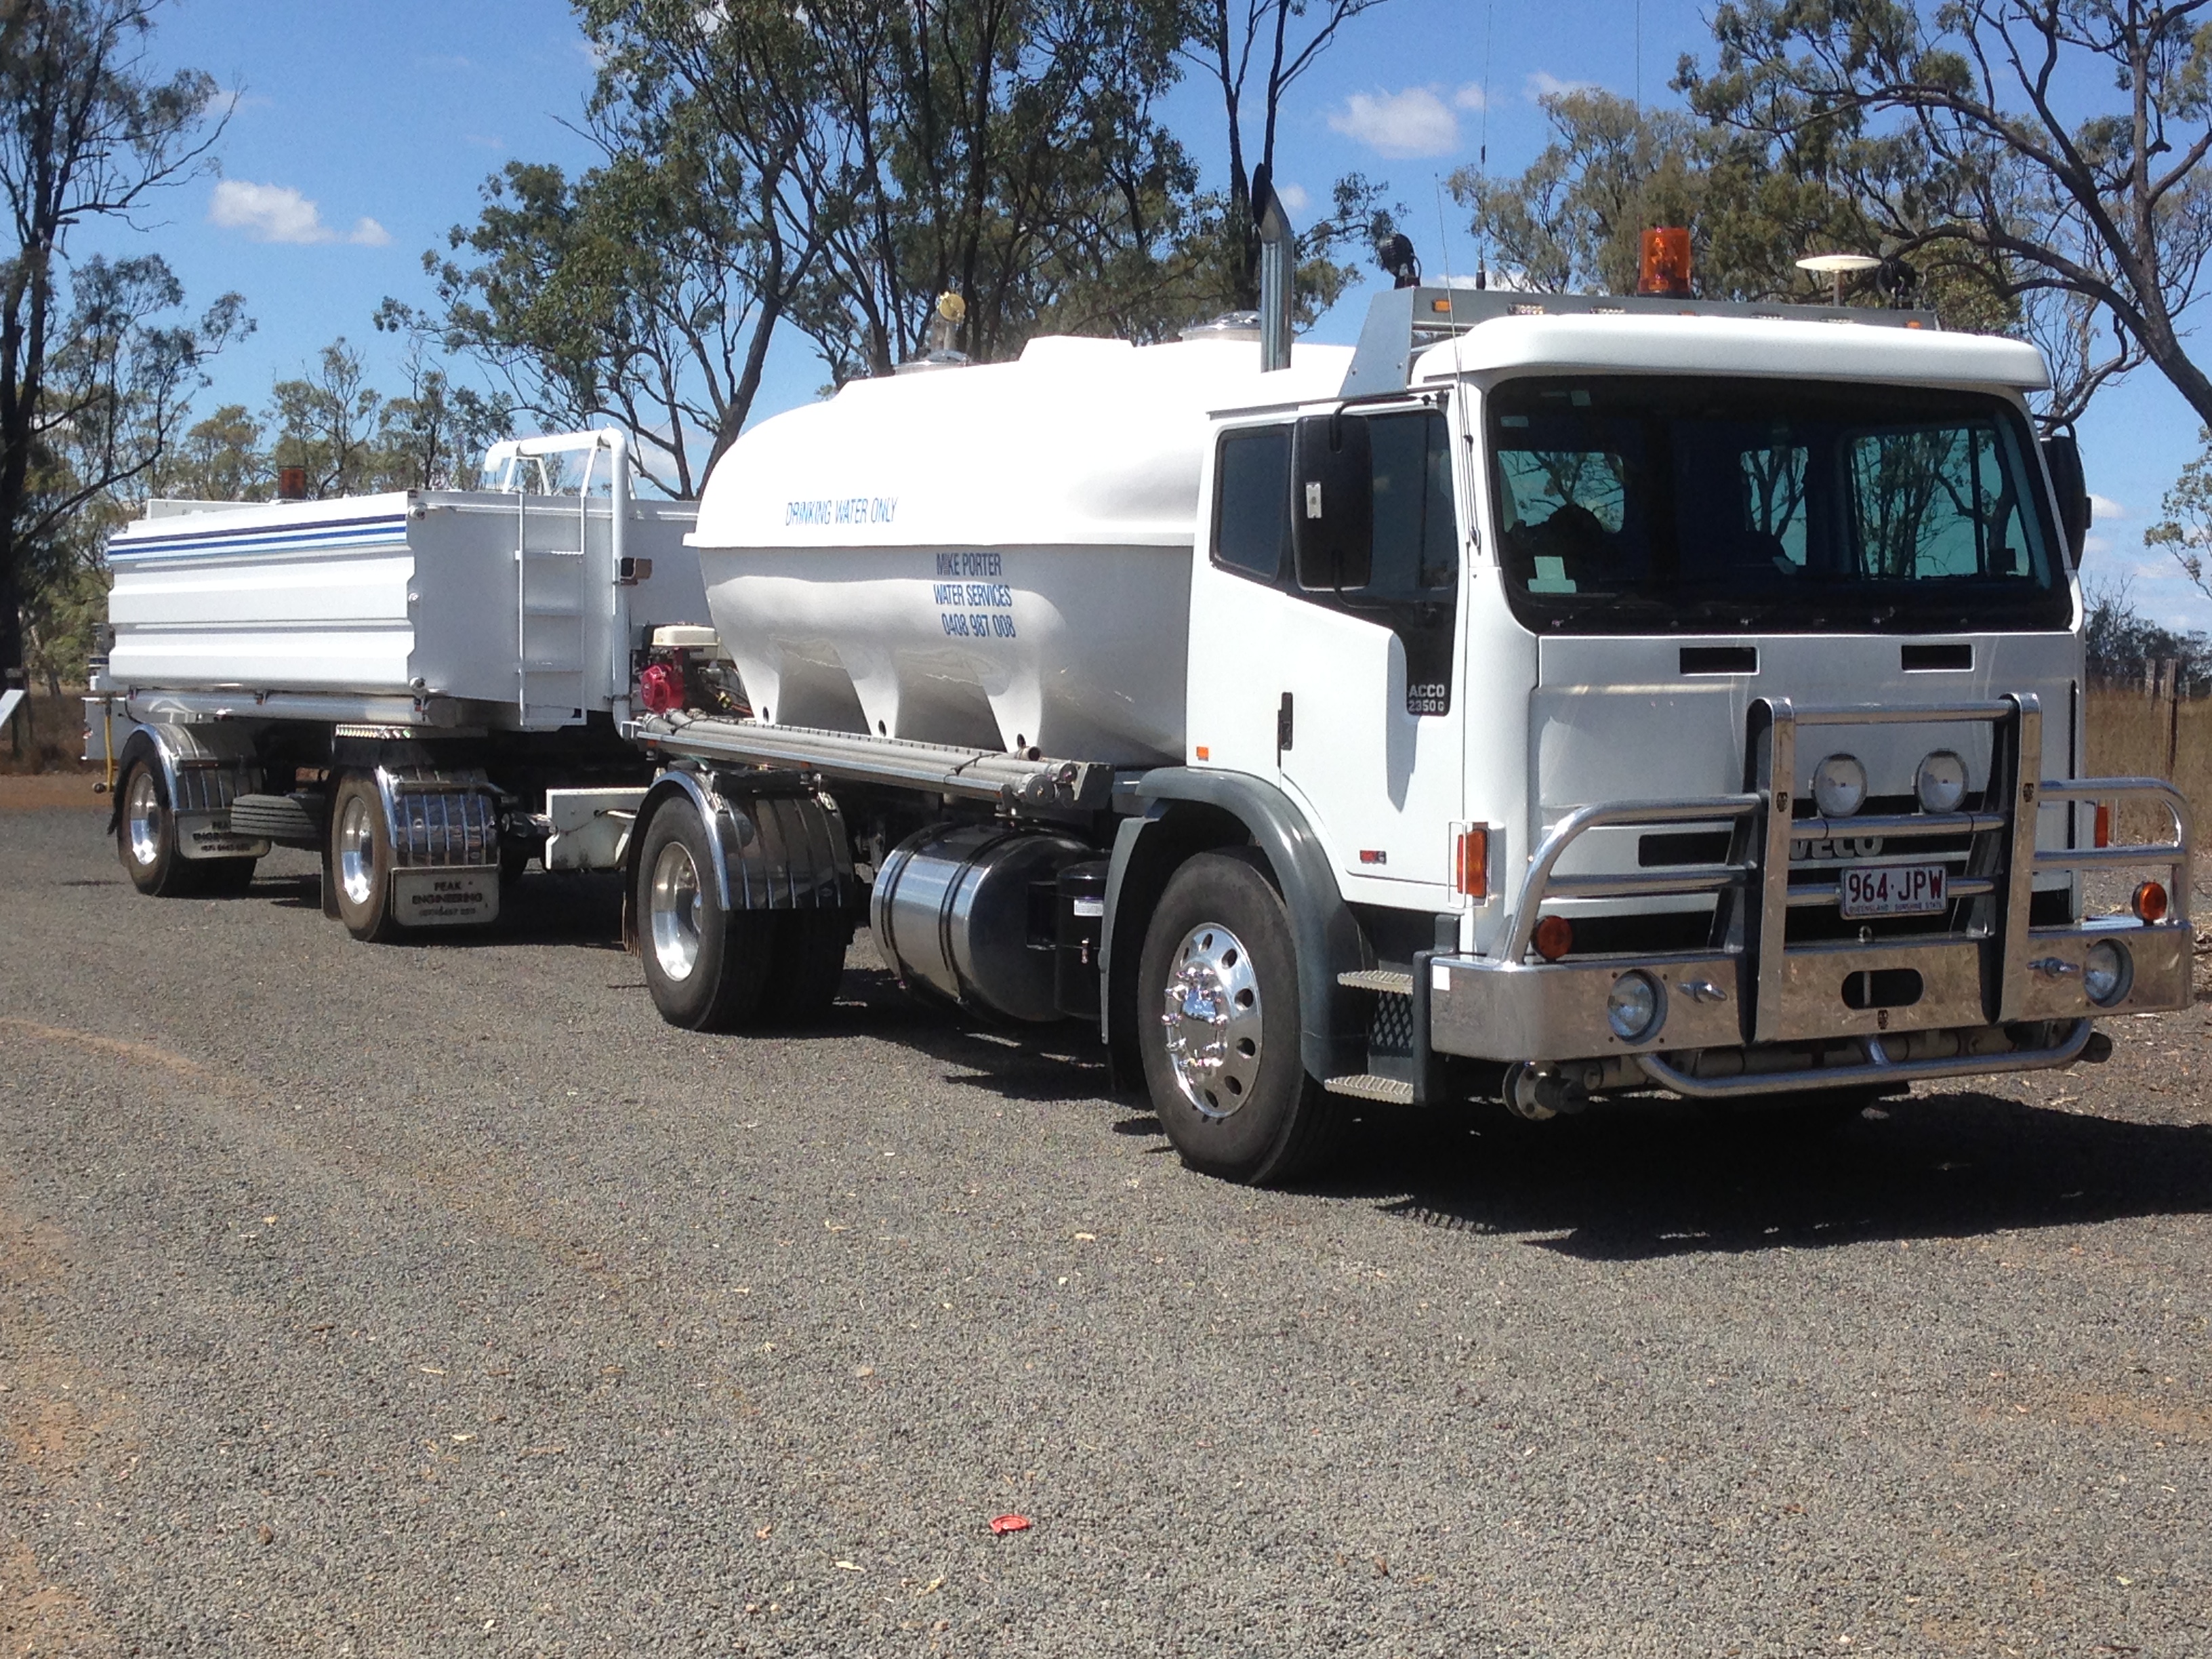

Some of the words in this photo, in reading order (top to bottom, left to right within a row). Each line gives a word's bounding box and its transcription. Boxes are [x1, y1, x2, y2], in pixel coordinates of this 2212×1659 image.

[785, 500, 832, 526] DRINKING
[835, 498, 868, 525] WATER
[871, 497, 899, 524] ONLY
[937, 552, 960, 576] MIKE
[962, 552, 1002, 576] PORTER
[933, 584, 965, 606] WATER
[966, 584, 1012, 607] SERVICES
[1408, 684, 1445, 698] ACCO
[1408, 699, 1437, 712] 2350
[1790, 836, 1884, 860] VECO
[434, 881, 462, 892] PEAK
